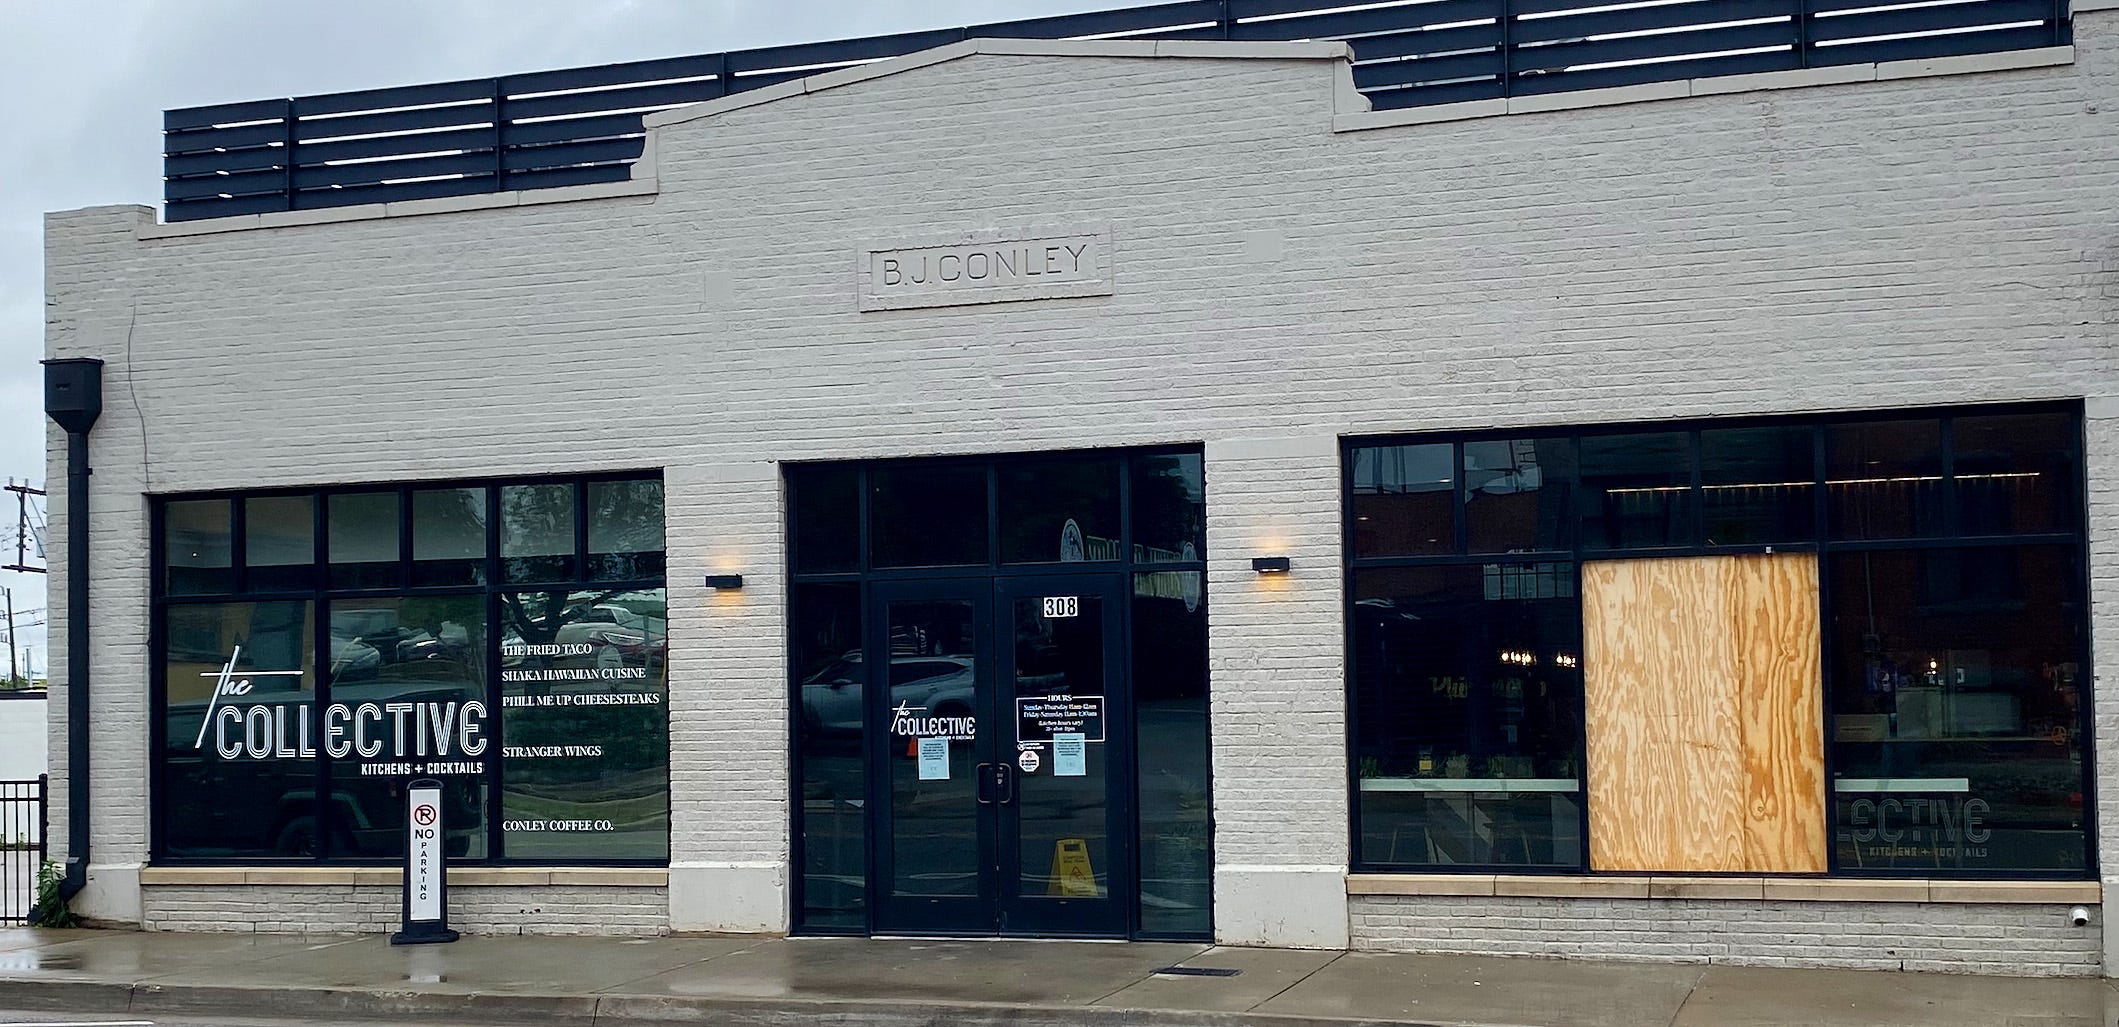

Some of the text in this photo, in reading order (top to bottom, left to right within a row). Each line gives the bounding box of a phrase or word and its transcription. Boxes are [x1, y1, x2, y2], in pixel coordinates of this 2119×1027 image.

[1045, 597, 1076, 616] 308
[503, 643, 593, 656] THE FRIED TACO
[502, 667, 646, 682] SHAKA HAWAIIAN CUISINE
[195, 645, 304, 749] the
[502, 692, 660, 707] PHILL ME UP CHEESESTEAKS
[1047, 694, 1073, 702] HOURS
[216, 700, 488, 760] COLLECTIVE
[898, 716, 976, 736] COLLECTIVE
[502, 745, 602, 758] STRANGER WINGS
[361, 763, 412, 776] KITCHENS
[426, 762, 483, 775] COCKTAILS
[502, 819, 615, 832] CONLEY COFFEE CO.
[415, 828, 435, 840] NO
[420, 841, 428, 901] PARKING
